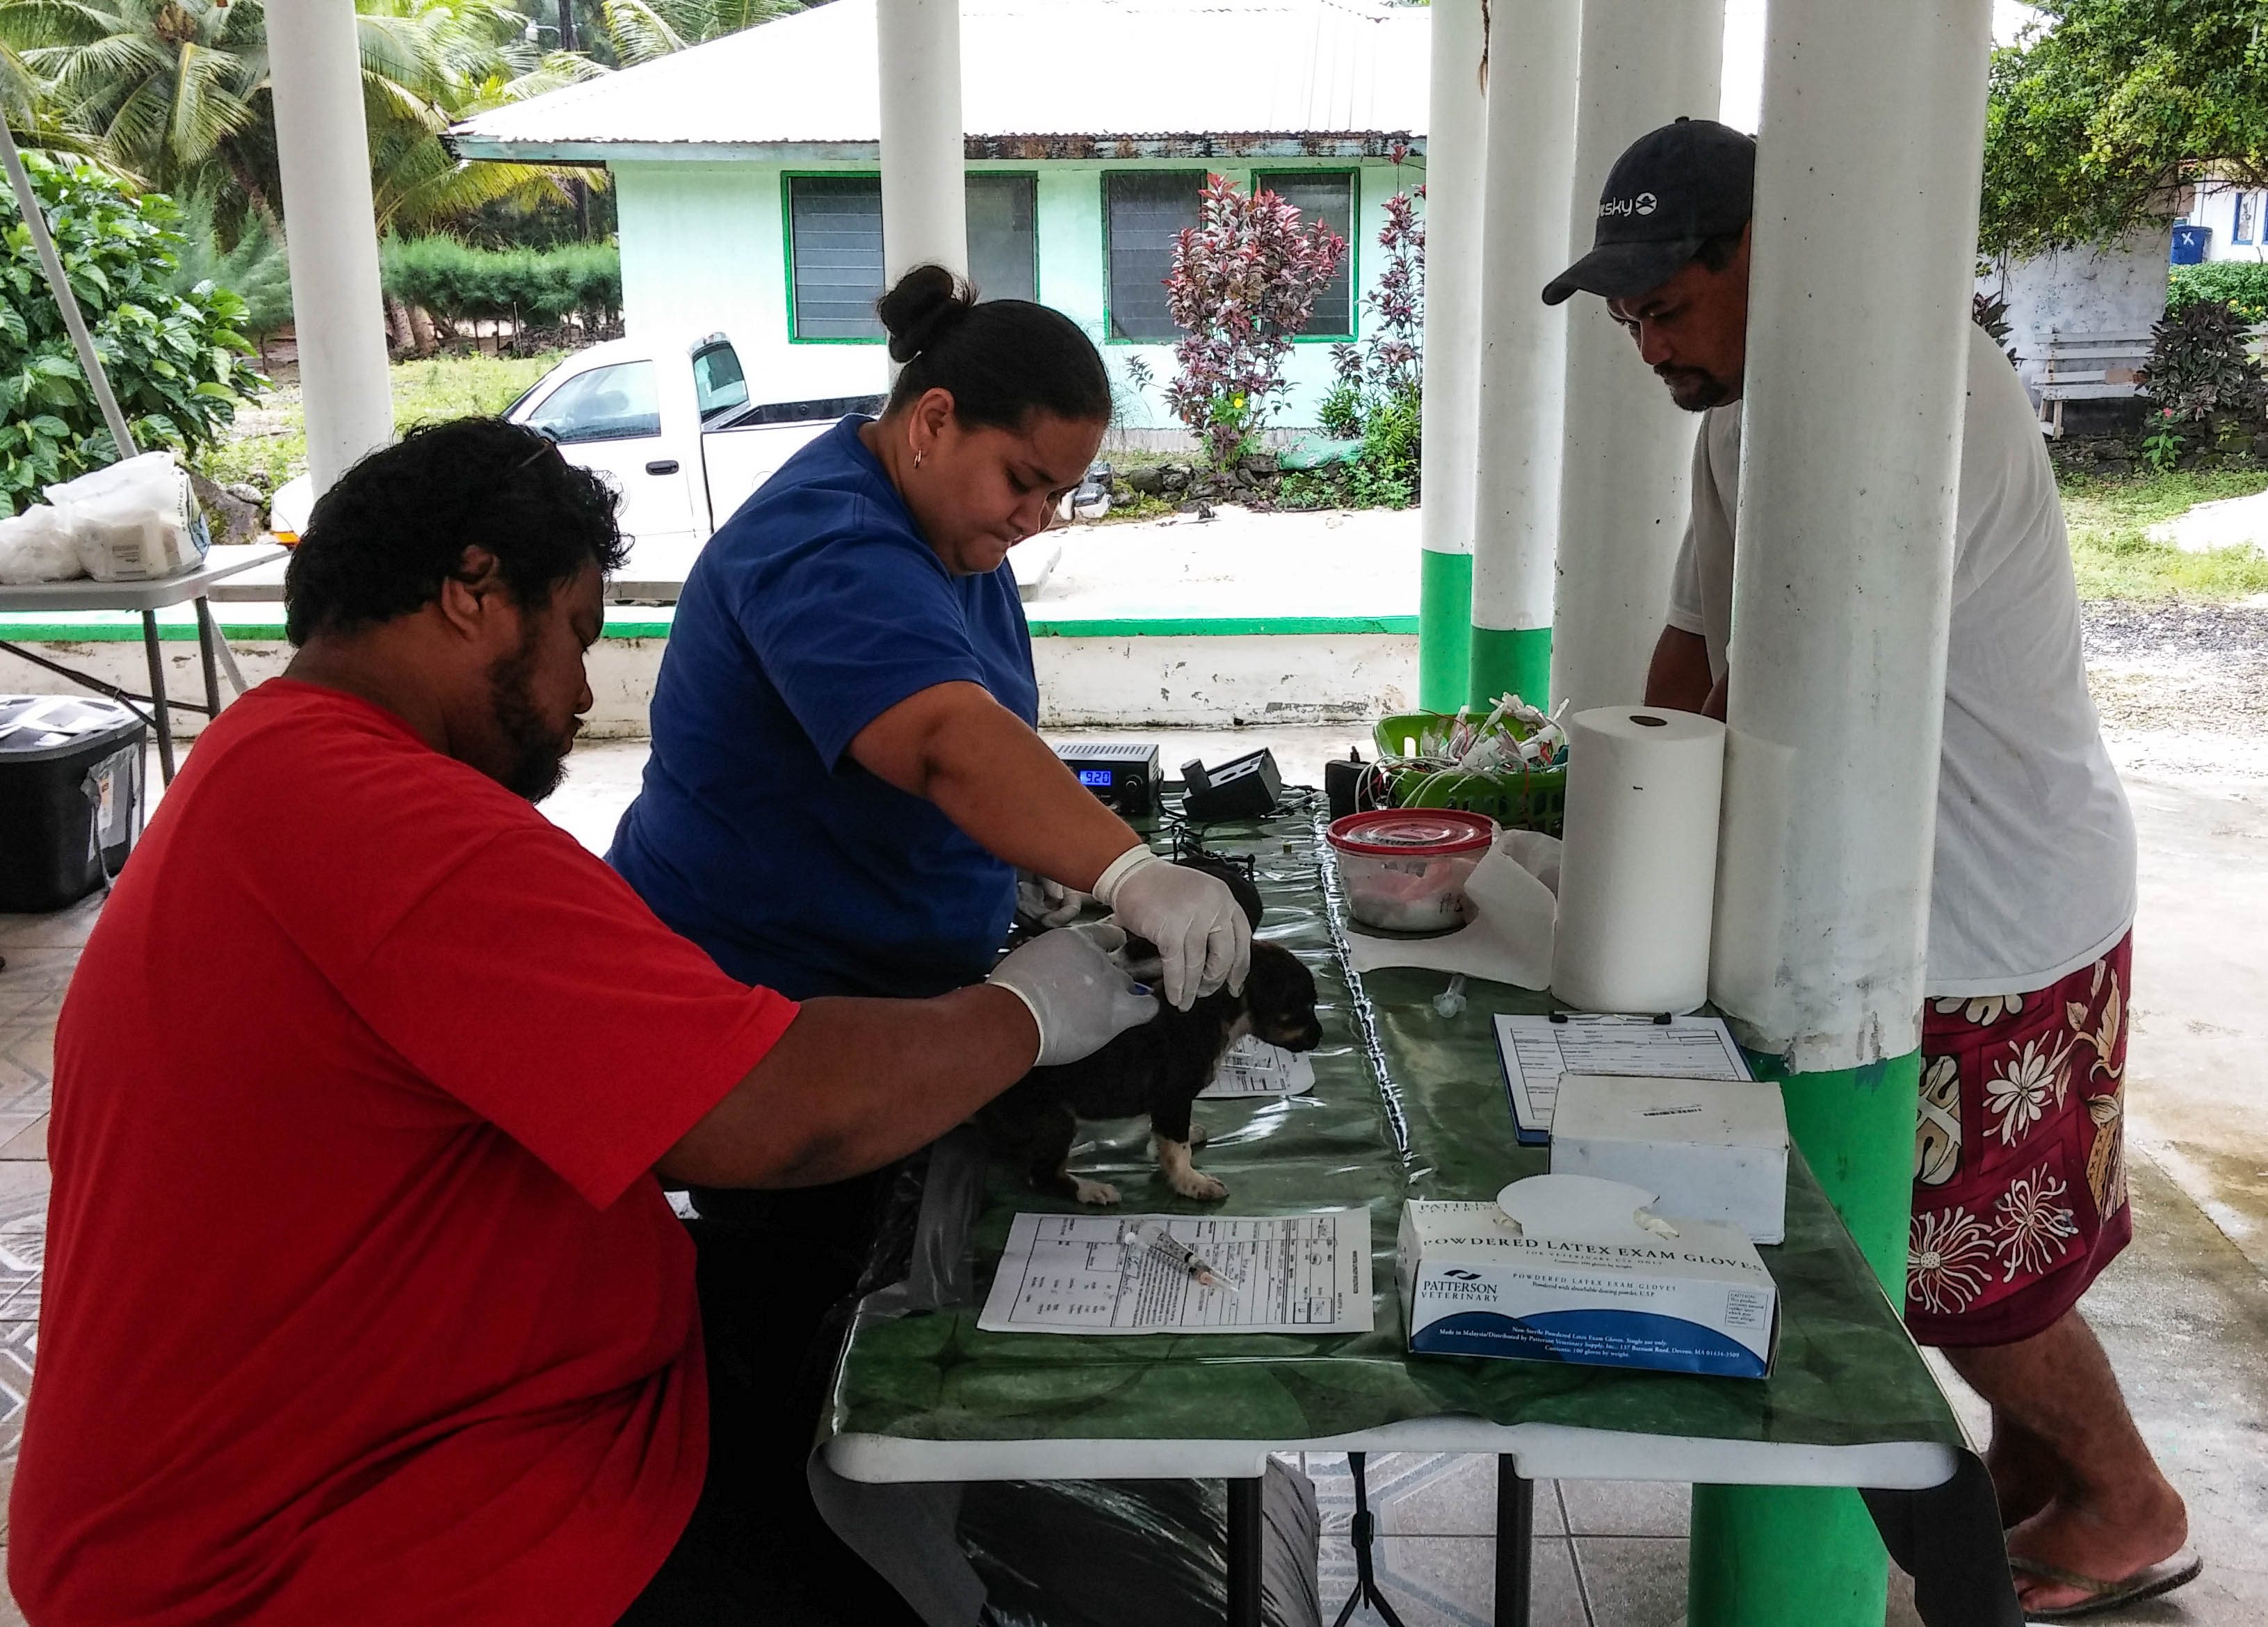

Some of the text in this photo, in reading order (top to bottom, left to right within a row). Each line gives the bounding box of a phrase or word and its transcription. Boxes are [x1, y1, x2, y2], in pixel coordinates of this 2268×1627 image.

[1423, 1238, 1762, 1272] POWDERED LATEX EXAM GLOVES
[1513, 1273, 1566, 1283] POWDERED
[1423, 1281, 1497, 1294] PATTERSON
[1532, 1281, 1557, 1289] Powdered
[1421, 1291, 1499, 1302] VETERINARY
[1544, 1329, 1571, 1338] Powdered
[1529, 1336, 1555, 1344] Patterson
[1555, 1338, 1583, 1347] Veterinary
